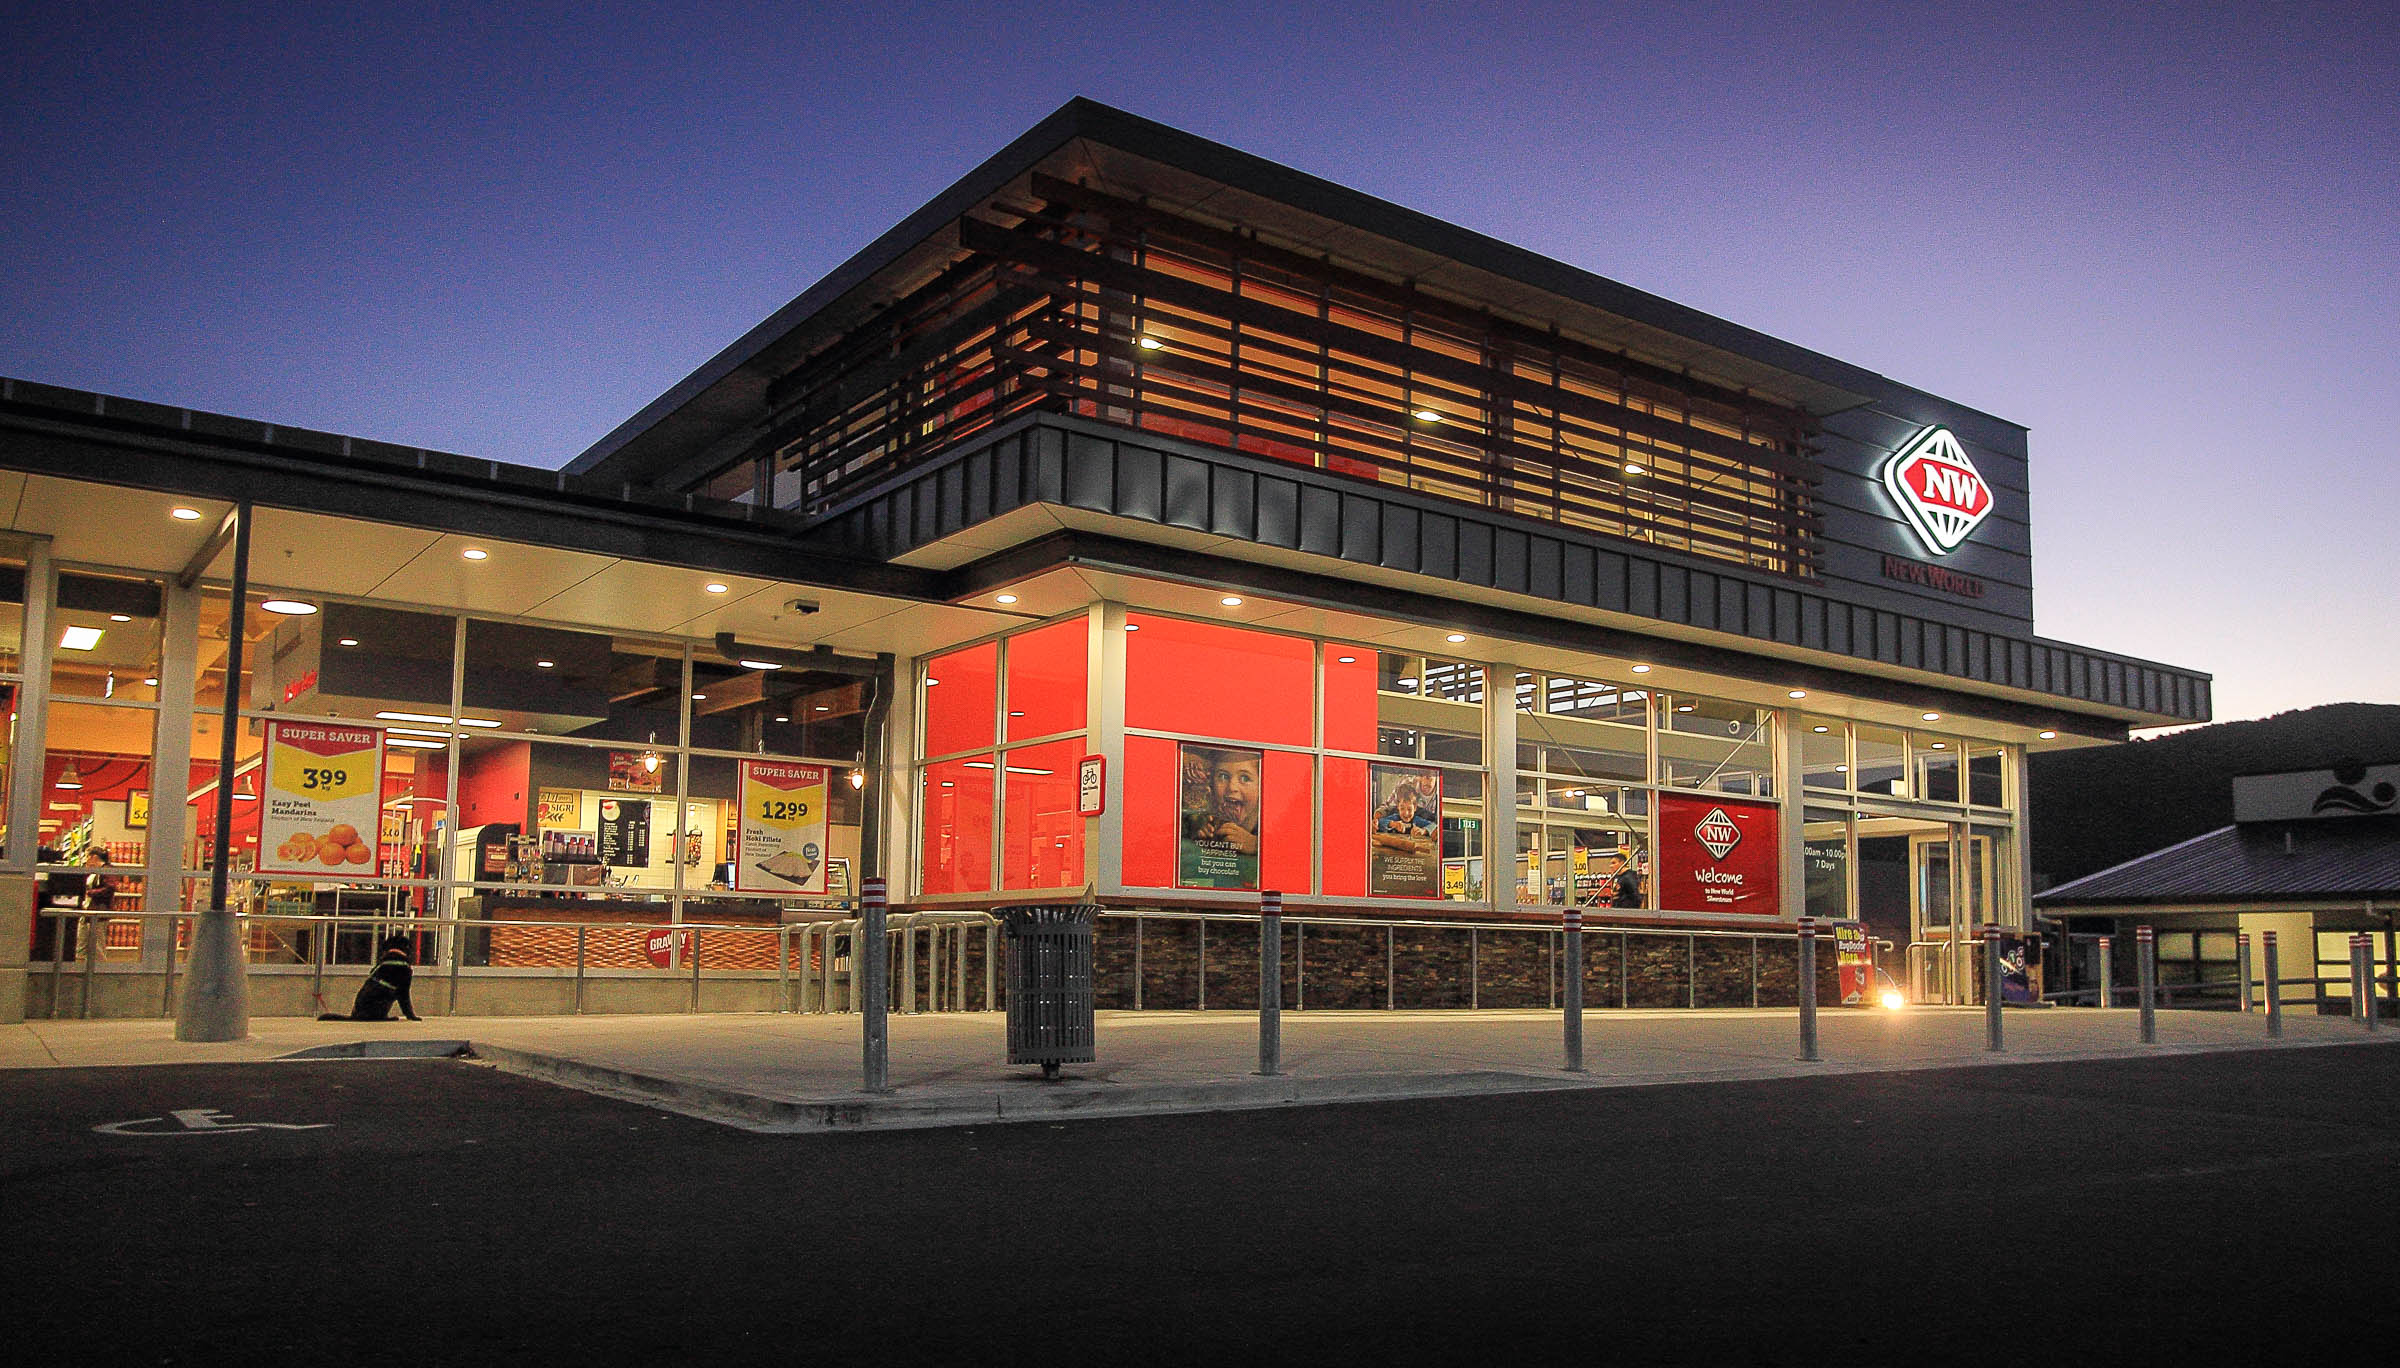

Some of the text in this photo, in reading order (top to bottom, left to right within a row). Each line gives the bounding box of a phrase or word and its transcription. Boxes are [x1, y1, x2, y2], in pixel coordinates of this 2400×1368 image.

[1922, 463, 1978, 510] NW
[1883, 556, 1984, 598] NEW WORLD
[282, 728, 371, 744] SUPER SAVER
[753, 766, 819, 780] SUPER SAVER
[272, 800, 292, 808] Easy
[133, 810, 149, 819] 5.0
[272, 808, 317, 816] Mandarins
[1706, 825, 1732, 842] NW
[1195, 840, 1243, 850] YOU CAN'T BUY
[1201, 848, 1237, 858] HAPPINESS
[1384, 856, 1394, 864] WE
[1415, 858, 1425, 866] THE
[1815, 860, 1835, 871] 7 Days
[1197, 866, 1240, 876] buy chocolate
[1387, 864, 1423, 872] INGREDIENTS
[1695, 867, 1743, 885] Welcome
[1446, 881, 1464, 890] 3.49
[1835, 927, 1853, 940] Hire
[650, 932, 687, 951] GRAVY
[1839, 951, 1859, 964] Here
